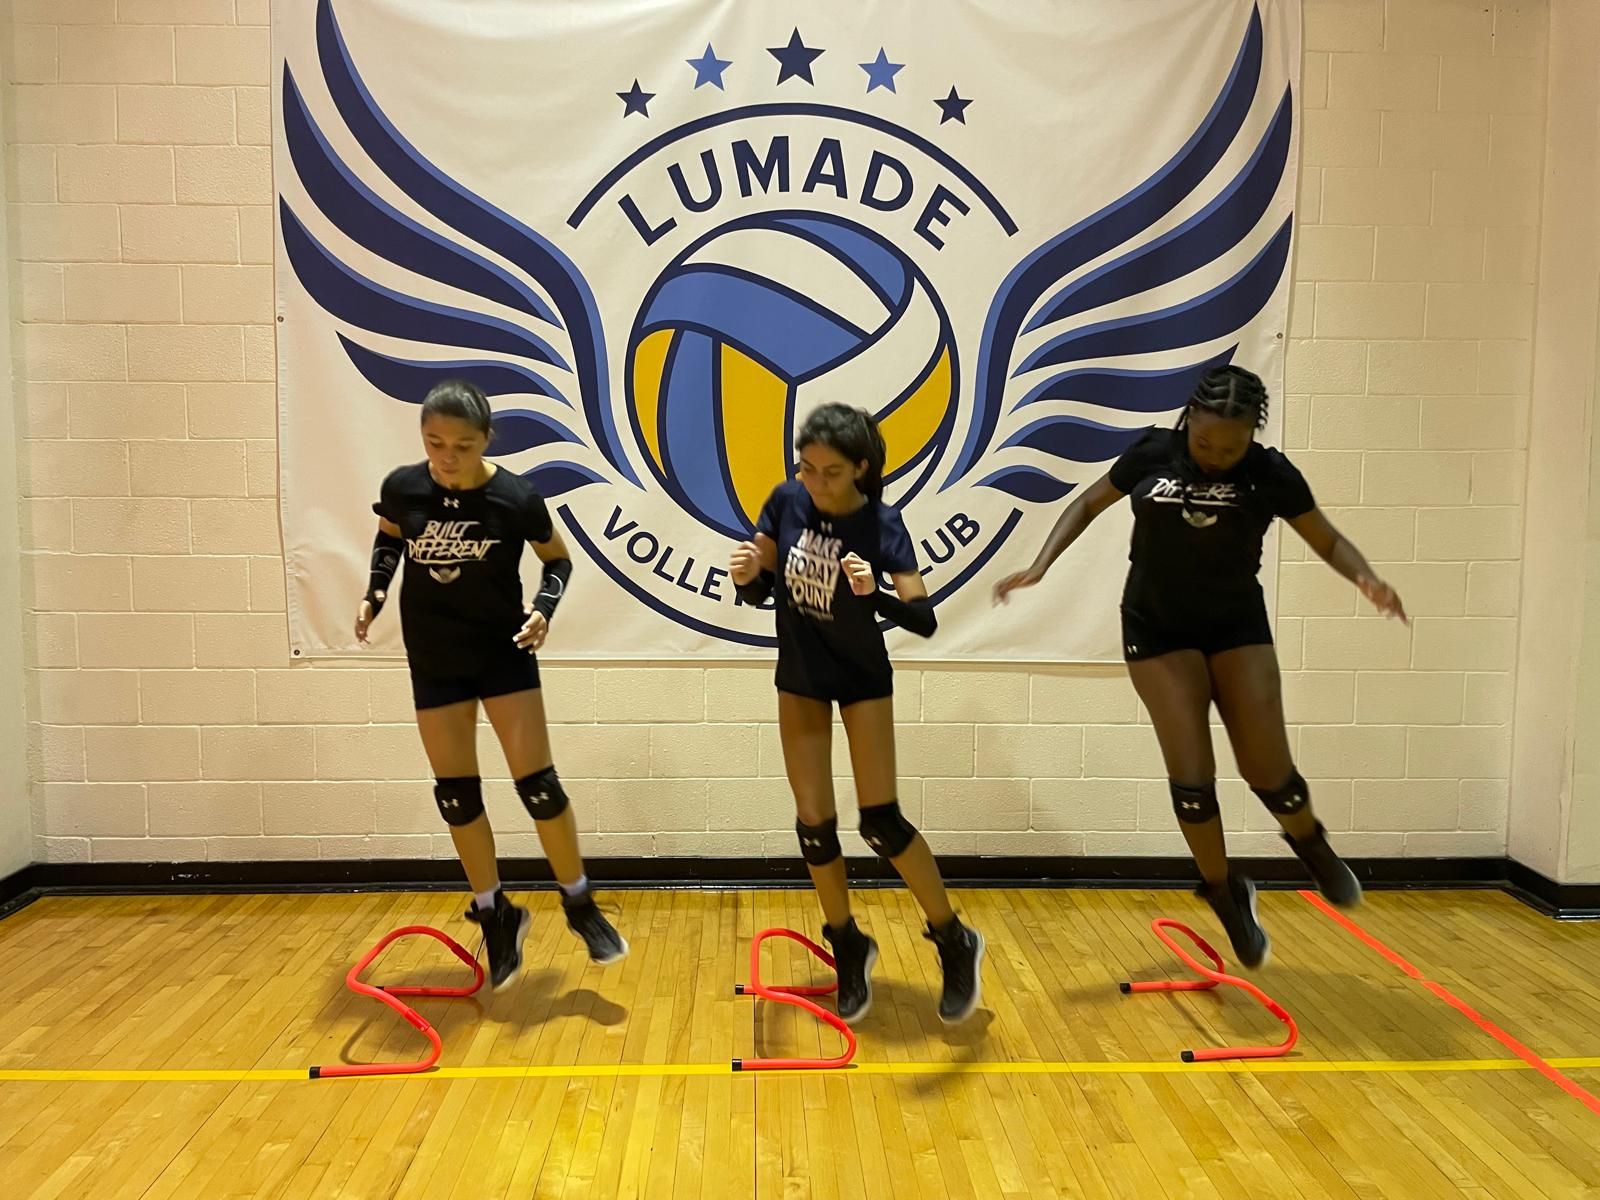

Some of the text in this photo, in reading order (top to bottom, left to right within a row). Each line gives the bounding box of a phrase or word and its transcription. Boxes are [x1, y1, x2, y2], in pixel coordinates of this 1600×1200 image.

[618, 136, 970, 251] LUMADE
[417, 520, 481, 540] BUILT
[796, 528, 843, 562] MAKE
[406, 537, 501, 560] DIFFERENT
[603, 505, 980, 610] VOLLE UB
